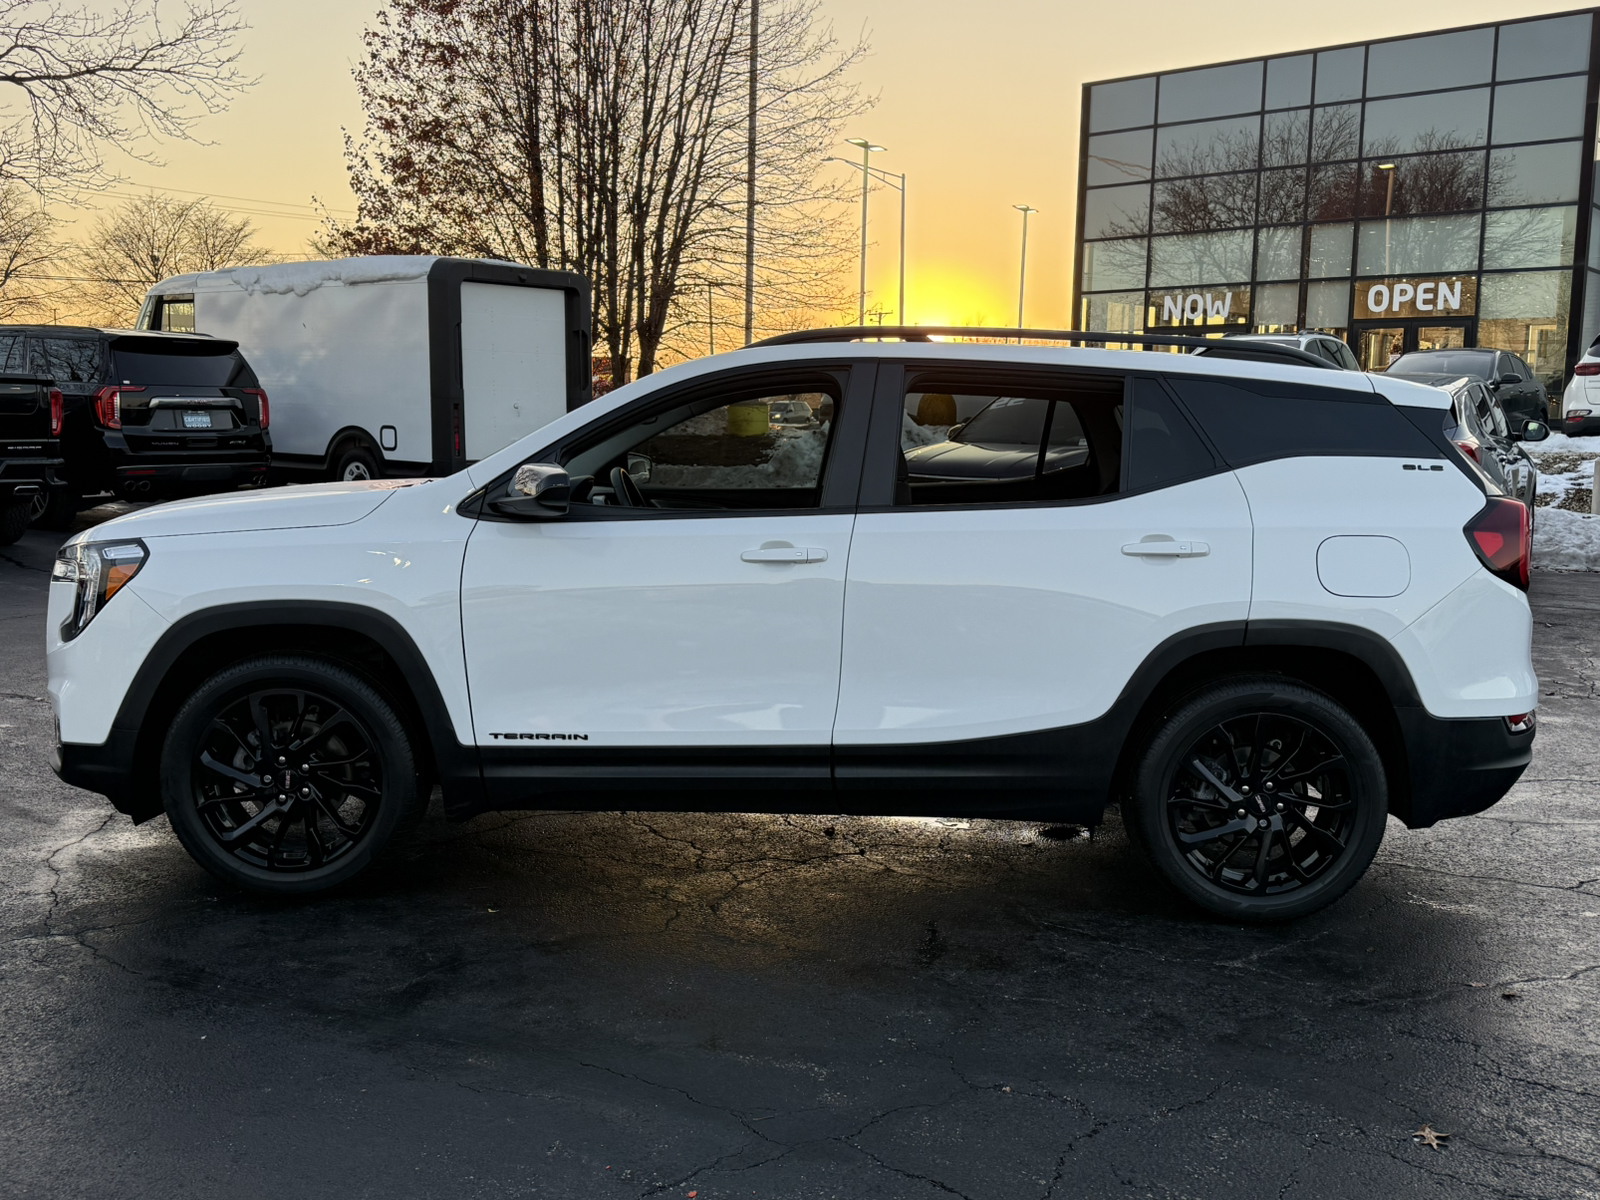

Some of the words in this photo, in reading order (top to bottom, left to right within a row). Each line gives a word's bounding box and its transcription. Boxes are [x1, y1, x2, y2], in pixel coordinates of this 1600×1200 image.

[1162, 292, 1233, 321] NOW
[1367, 281, 1462, 313] OPEN
[488, 733, 588, 741] TERRAIN
